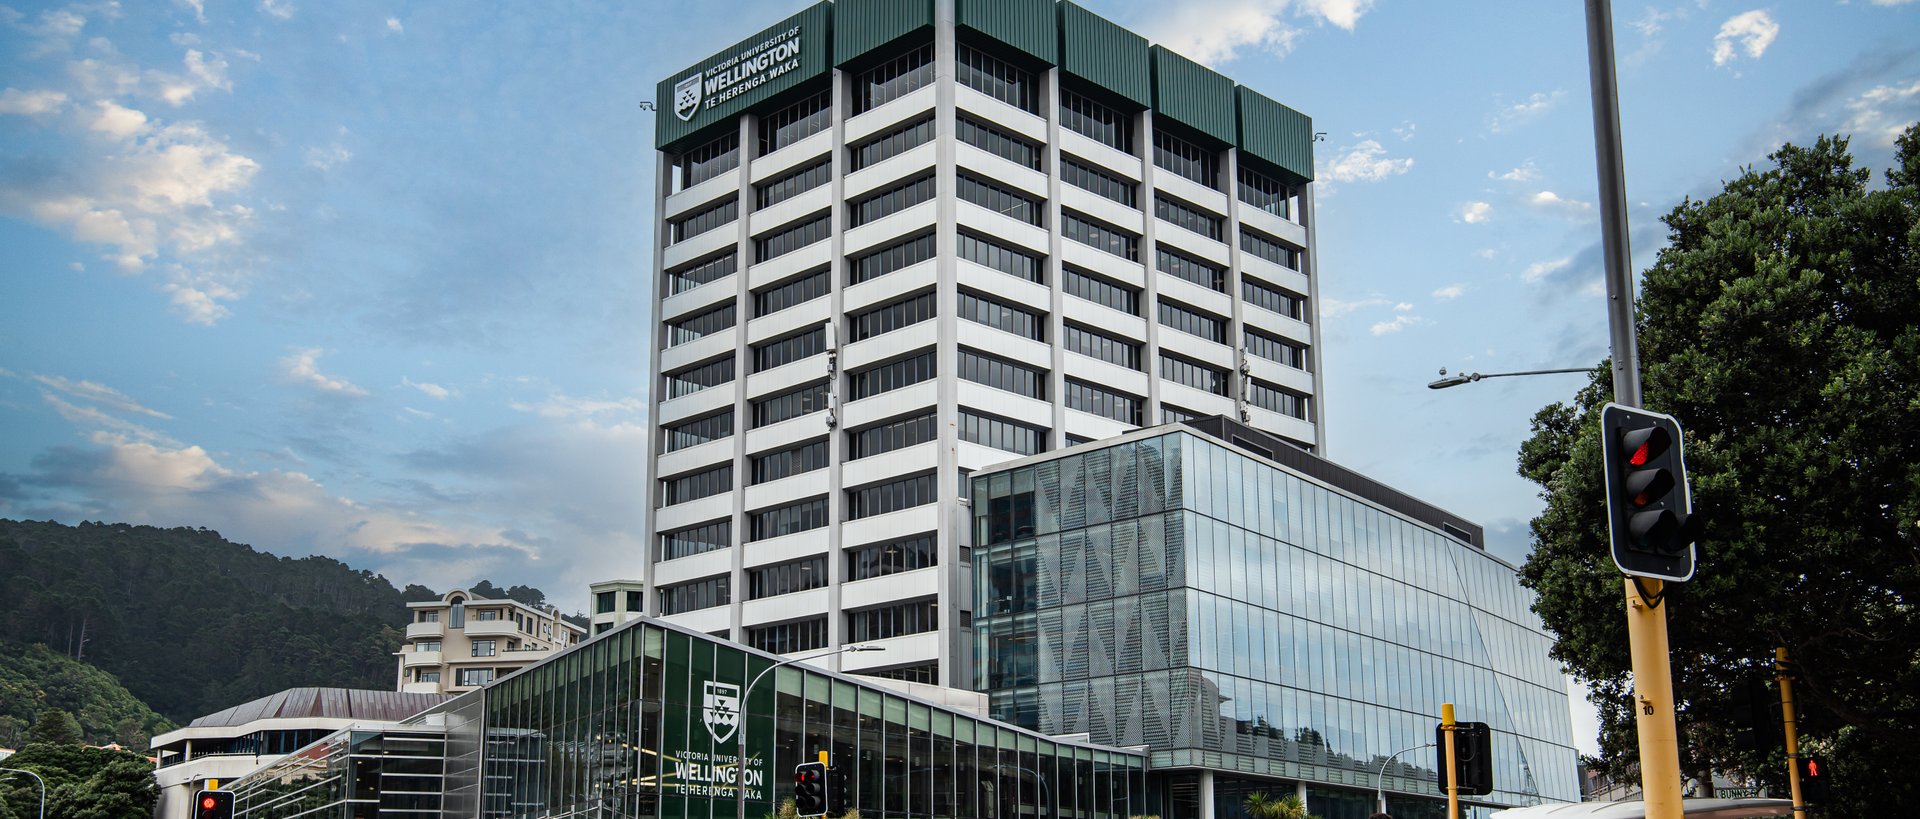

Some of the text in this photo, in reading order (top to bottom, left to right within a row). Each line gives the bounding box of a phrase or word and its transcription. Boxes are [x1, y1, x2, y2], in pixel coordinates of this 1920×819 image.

[705, 26, 800, 78] VICTORIA UNIVERSITY OF
[704, 37, 800, 96] WELLINGTON
[705, 60, 799, 110] TE HERENGA WAKA
[1643, 705, 1654, 715] 10
[675, 750, 763, 766] VICTORIA UNIVERTY OF
[675, 762, 763, 786] WELLINGON
[674, 783, 762, 800] TE HERENGA AKA
[1721, 789, 1747, 799] BUNNY
